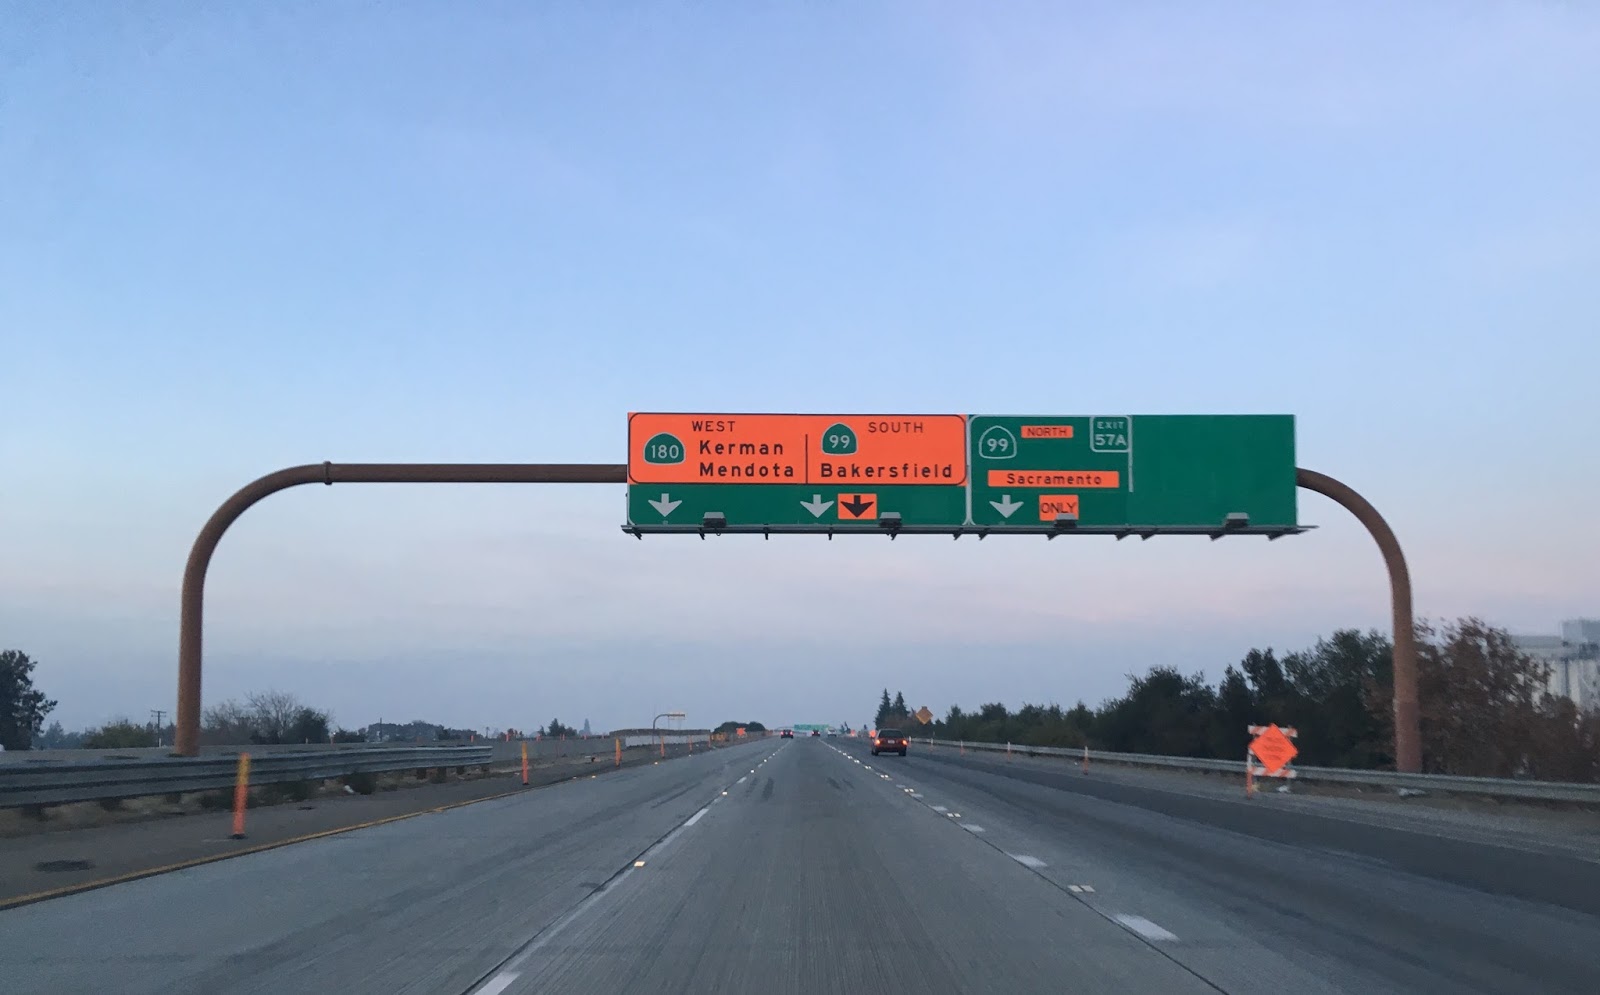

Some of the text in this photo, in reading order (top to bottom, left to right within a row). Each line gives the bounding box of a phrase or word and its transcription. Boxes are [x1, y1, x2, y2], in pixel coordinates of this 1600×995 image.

[692, 421, 736, 432] WEST
[868, 422, 924, 433] SOUTH
[1097, 421, 1125, 429] EXIT
[1027, 428, 1067, 437] NORTH
[829, 434, 851, 449] 99
[987, 438, 1009, 452] 99
[1095, 434, 1127, 446] 57A
[651, 444, 679, 459] 180
[699, 440, 784, 455] Kerman
[699, 462, 794, 477] Mendota
[820, 463, 952, 478] Bakersfield
[1006, 473, 1103, 485] Sacramento
[1040, 502, 1077, 514] ONLY
